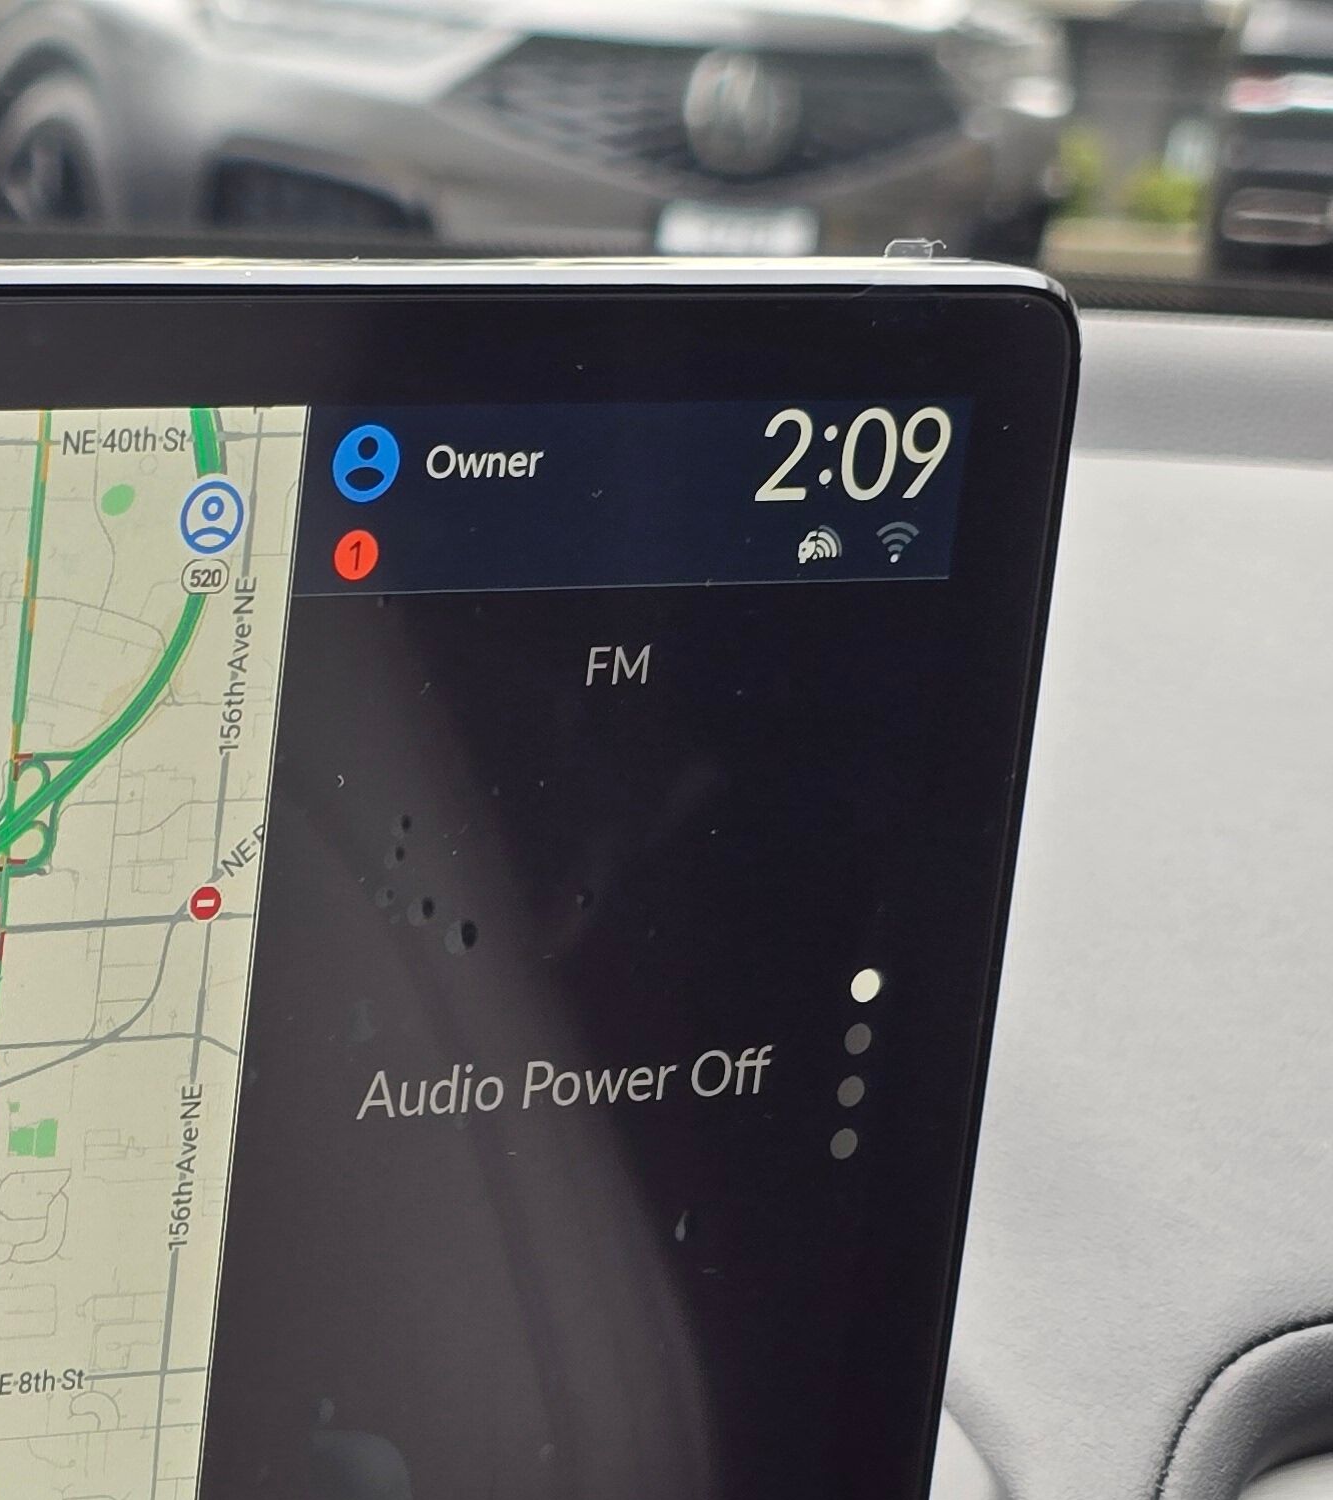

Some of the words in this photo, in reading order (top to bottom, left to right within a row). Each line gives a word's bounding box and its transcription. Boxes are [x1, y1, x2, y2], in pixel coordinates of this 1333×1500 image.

[63, 429, 96, 454] NE
[102, 428, 156, 453] 40th
[163, 427, 186, 451] St
[754, 406, 952, 502] 2:09
[425, 445, 544, 480] Owner
[349, 541, 364, 571] 1
[190, 570, 222, 587] 520
[233, 577, 257, 615] NE
[228, 624, 252, 673] Ave
[585, 644, 652, 686] FM
[220, 681, 245, 754] 156th
[180, 1084, 202, 1119] NE
[356, 1062, 504, 1121] Audio
[522, 1057, 675, 1110] Power
[691, 1045, 774, 1096] Off
[176, 1128, 199, 1173] Ave
[169, 1181, 193, 1250] 156th
[18, 1369, 55, 1394] 8th
[62, 1369, 84, 1390] St
